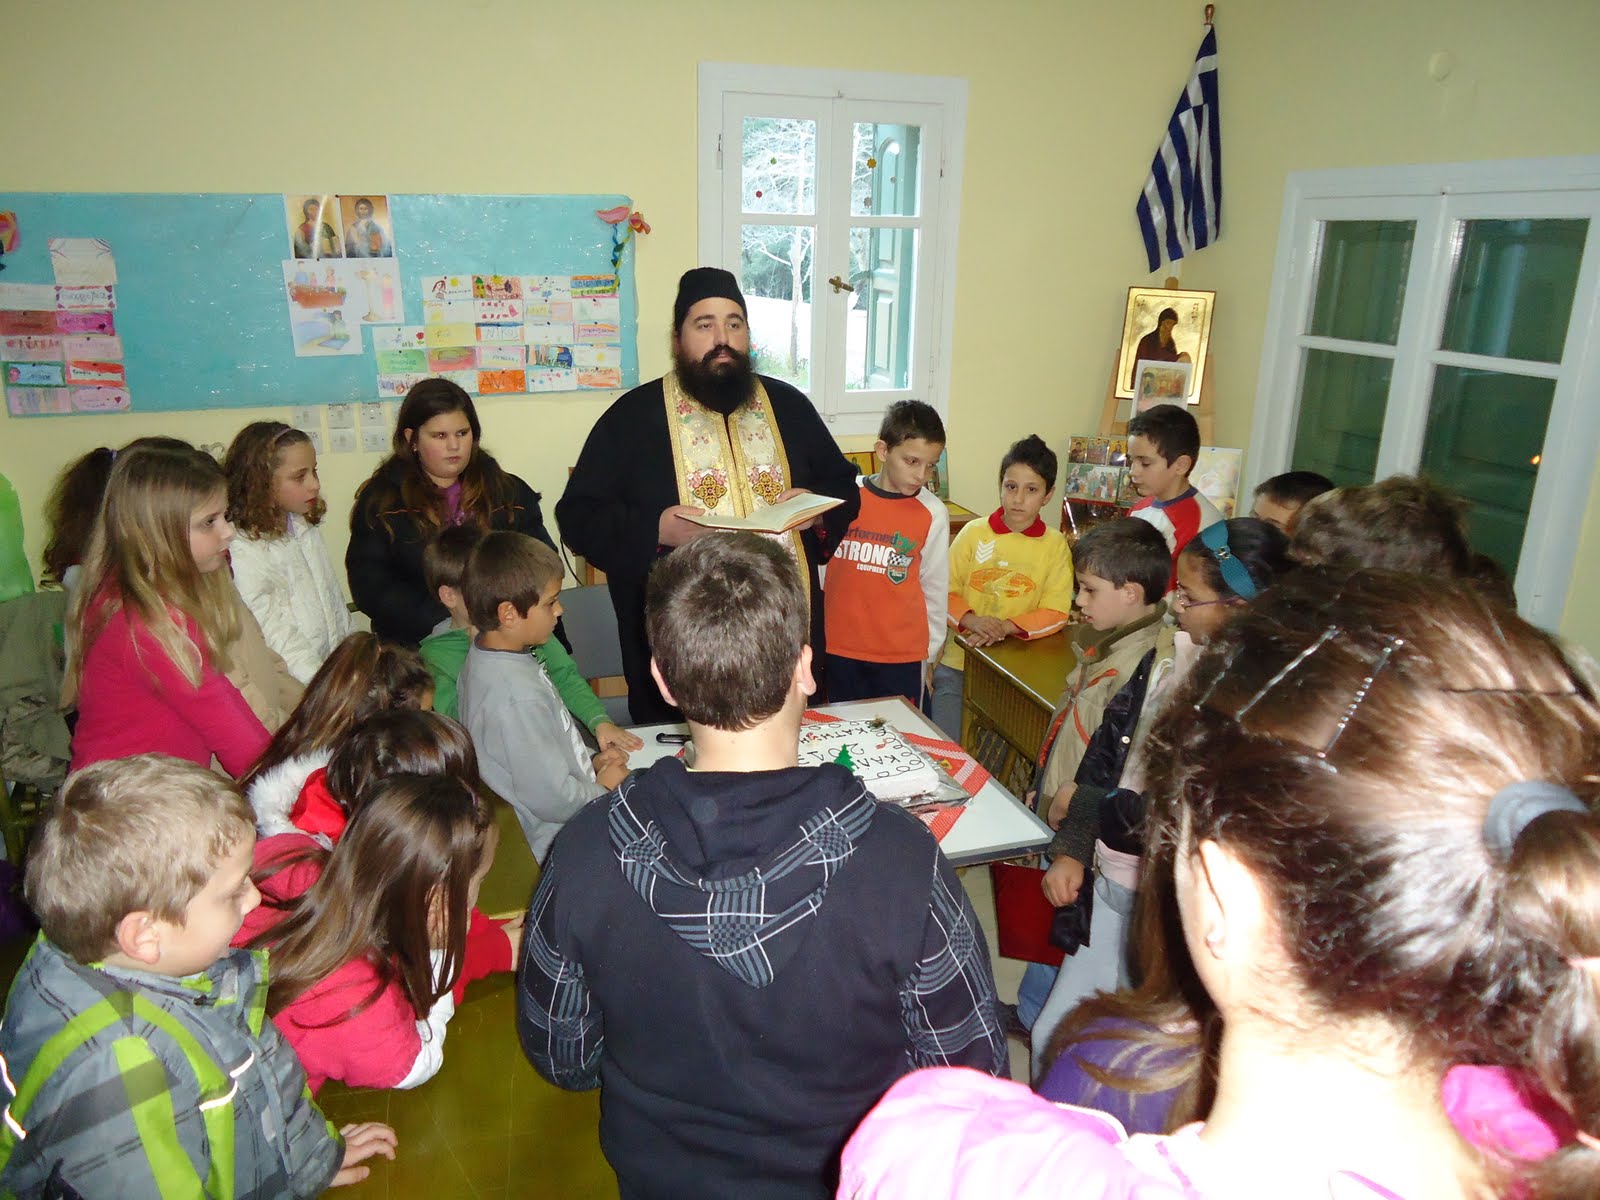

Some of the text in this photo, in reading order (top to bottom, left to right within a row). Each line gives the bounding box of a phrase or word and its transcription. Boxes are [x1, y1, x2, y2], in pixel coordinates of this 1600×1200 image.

[834, 540, 896, 567] STRONG
[856, 563, 886, 575] EQUIPMENT
[852, 755, 901, 770] ΚΑΛ
